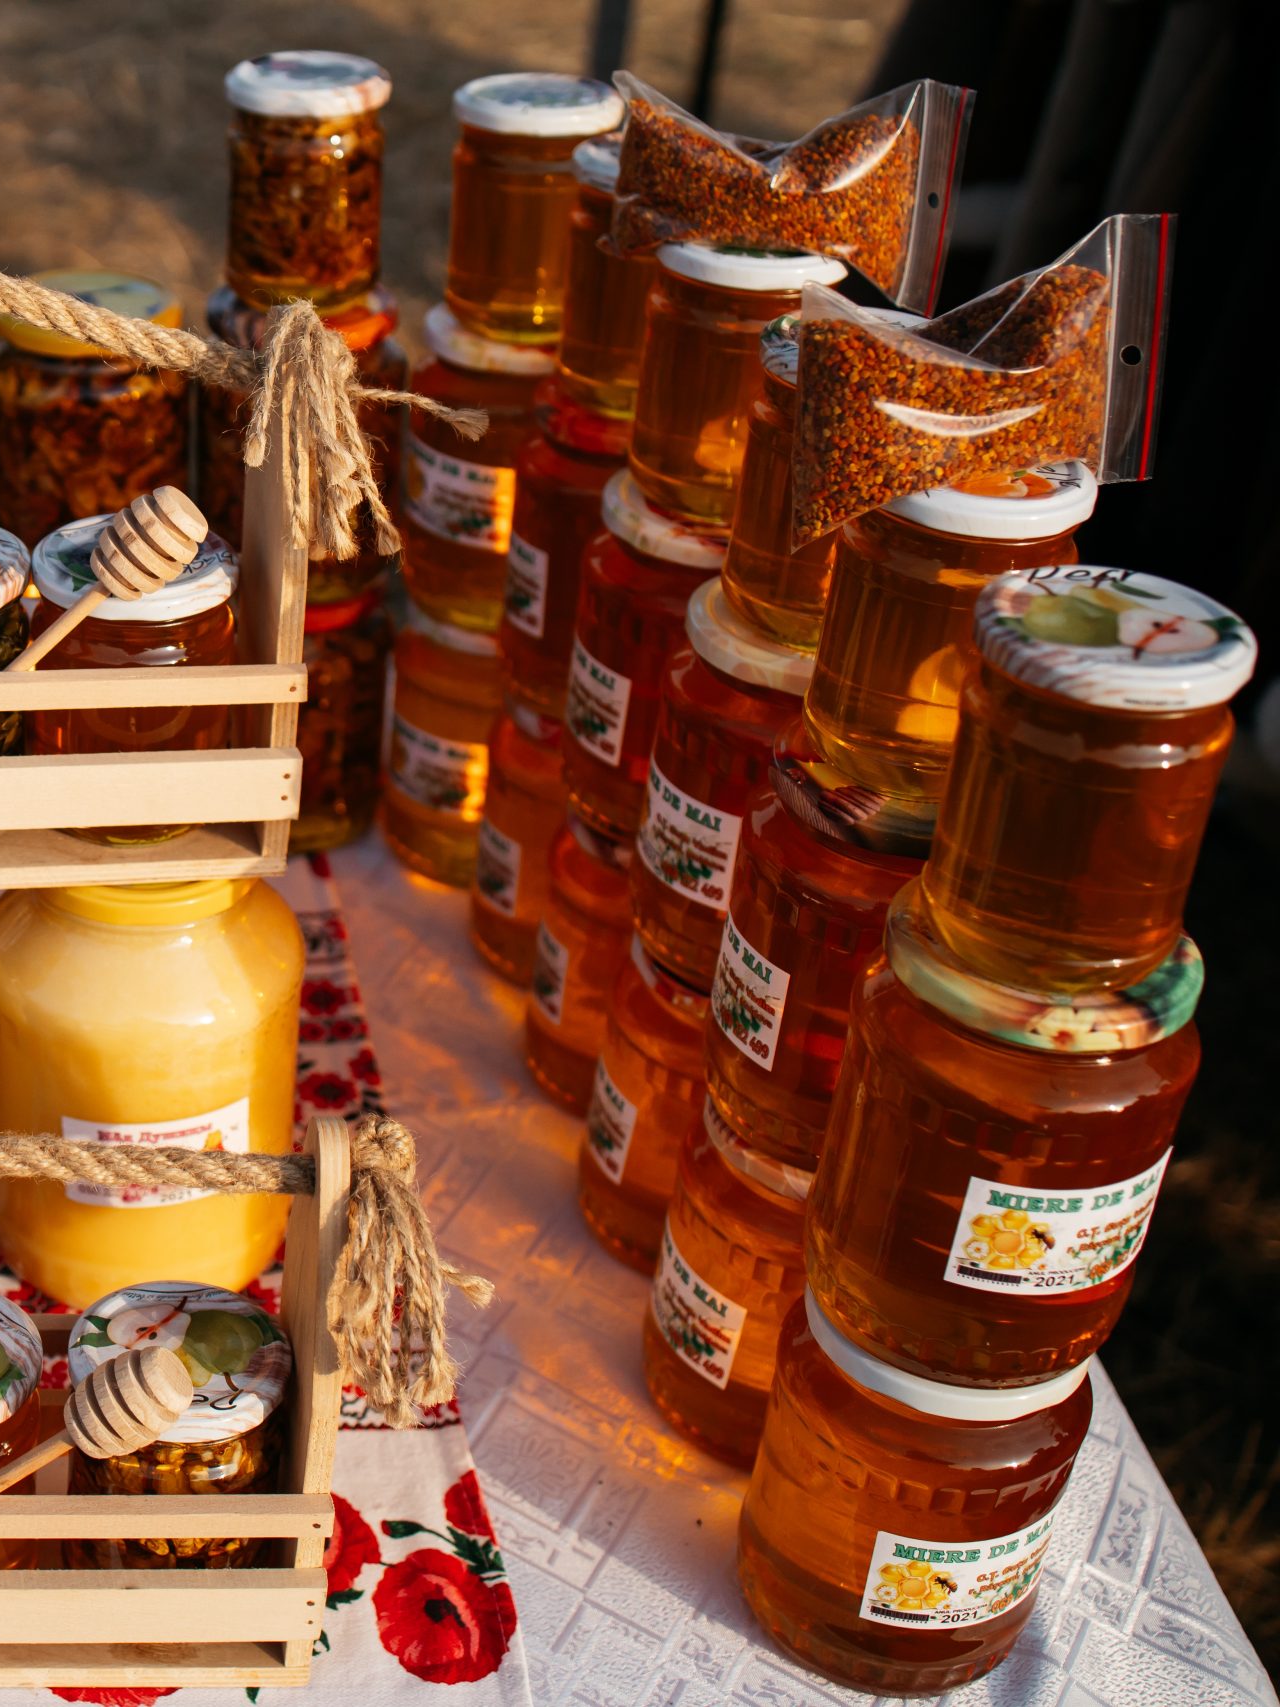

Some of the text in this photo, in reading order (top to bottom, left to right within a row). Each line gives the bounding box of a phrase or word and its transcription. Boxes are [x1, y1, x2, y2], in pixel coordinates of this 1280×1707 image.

[986, 1189, 1083, 1213] MIERE
[1091, 1190, 1125, 1211] DE
[1033, 1274, 1075, 1288] 2021
[893, 1543, 981, 1564] MIERE
[988, 1538, 1019, 1560] DE
[940, 1611, 979, 1624] 2021
